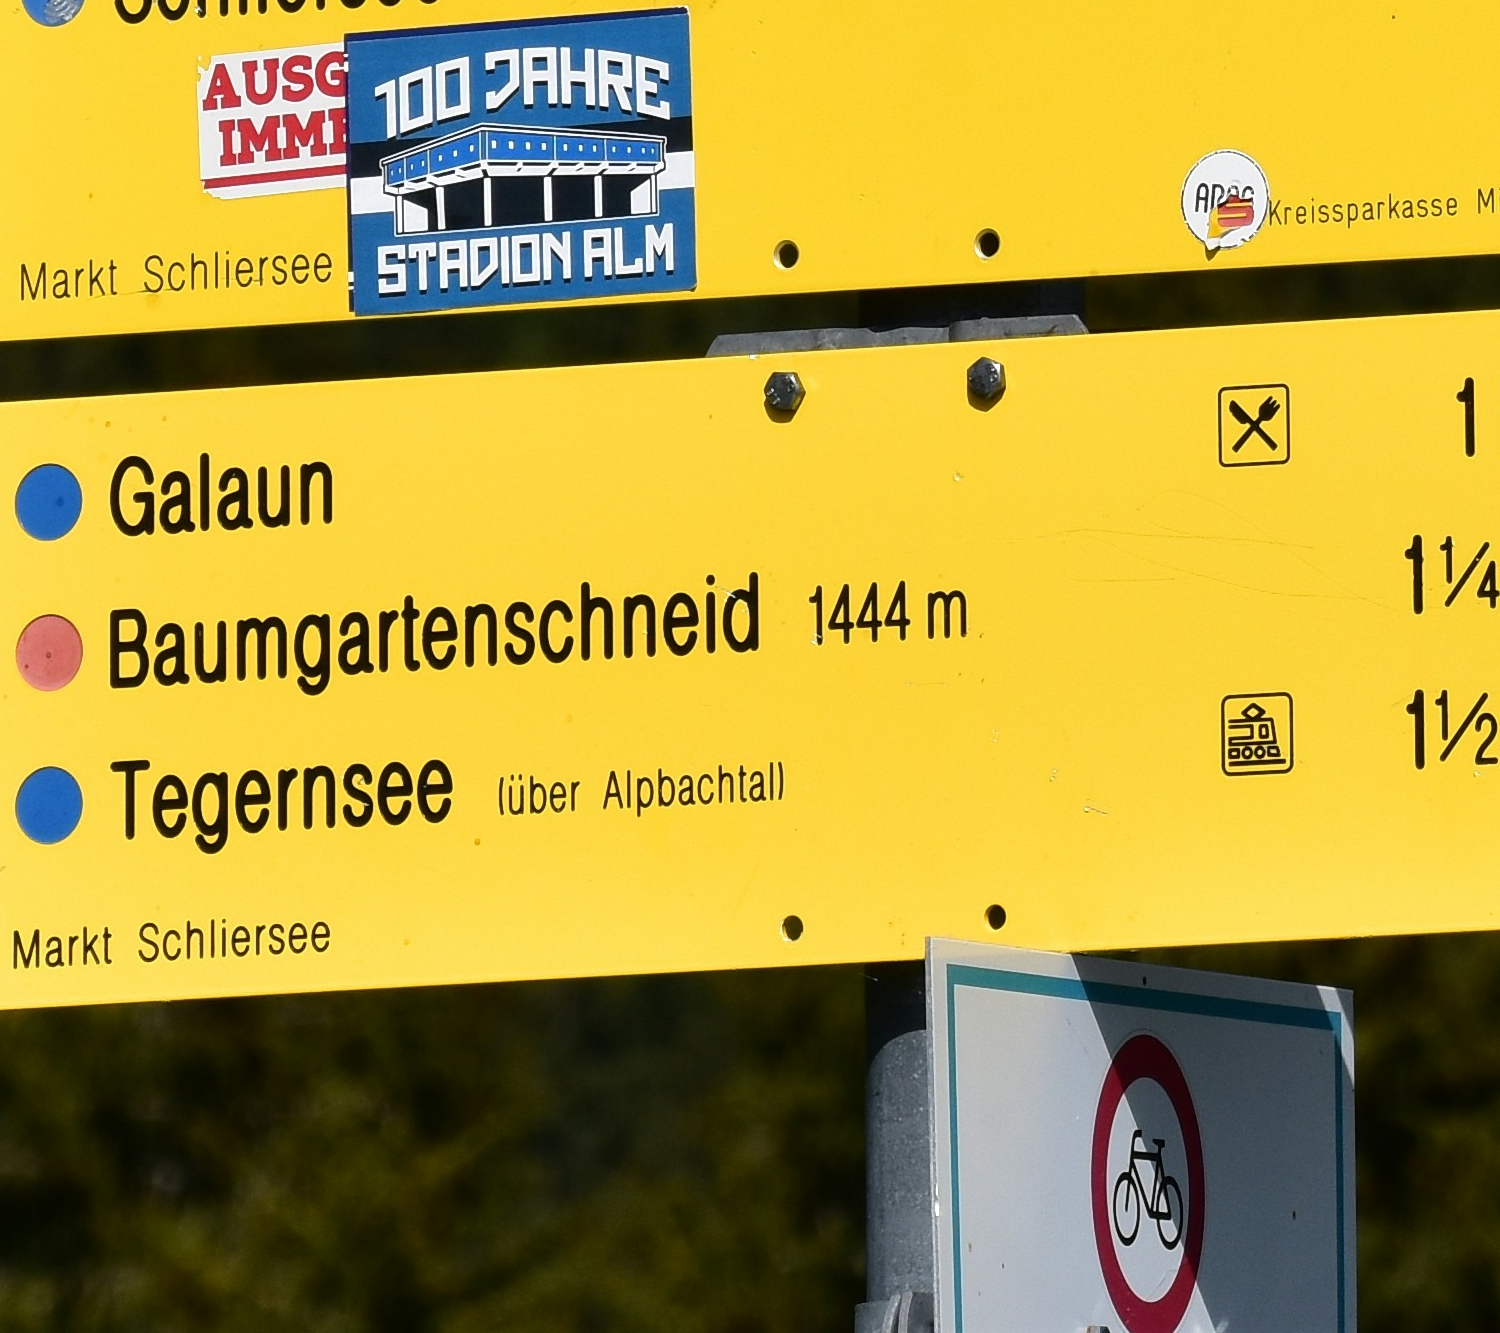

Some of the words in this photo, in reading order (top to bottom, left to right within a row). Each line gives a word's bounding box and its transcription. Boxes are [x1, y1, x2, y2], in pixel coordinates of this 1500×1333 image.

[374, 55, 472, 140] 100
[485, 46, 671, 121] JAHRE
[1267, 193, 1458, 229] Kreissparkasse
[20, 259, 118, 302] Markt
[140, 251, 333, 294] Schliersee
[377, 230, 572, 295] STADION
[585, 222, 675, 279] ALM
[109, 452, 333, 537] Galaun
[109, 571, 760, 697] Baumgartenschneid
[109, 759, 454, 855] Tegernsee
[498, 775, 581, 816] (über
[602, 761, 784, 814] Alpbachtal)
[13, 926, 113, 970] Markt
[138, 918, 331, 963] Schliersee
